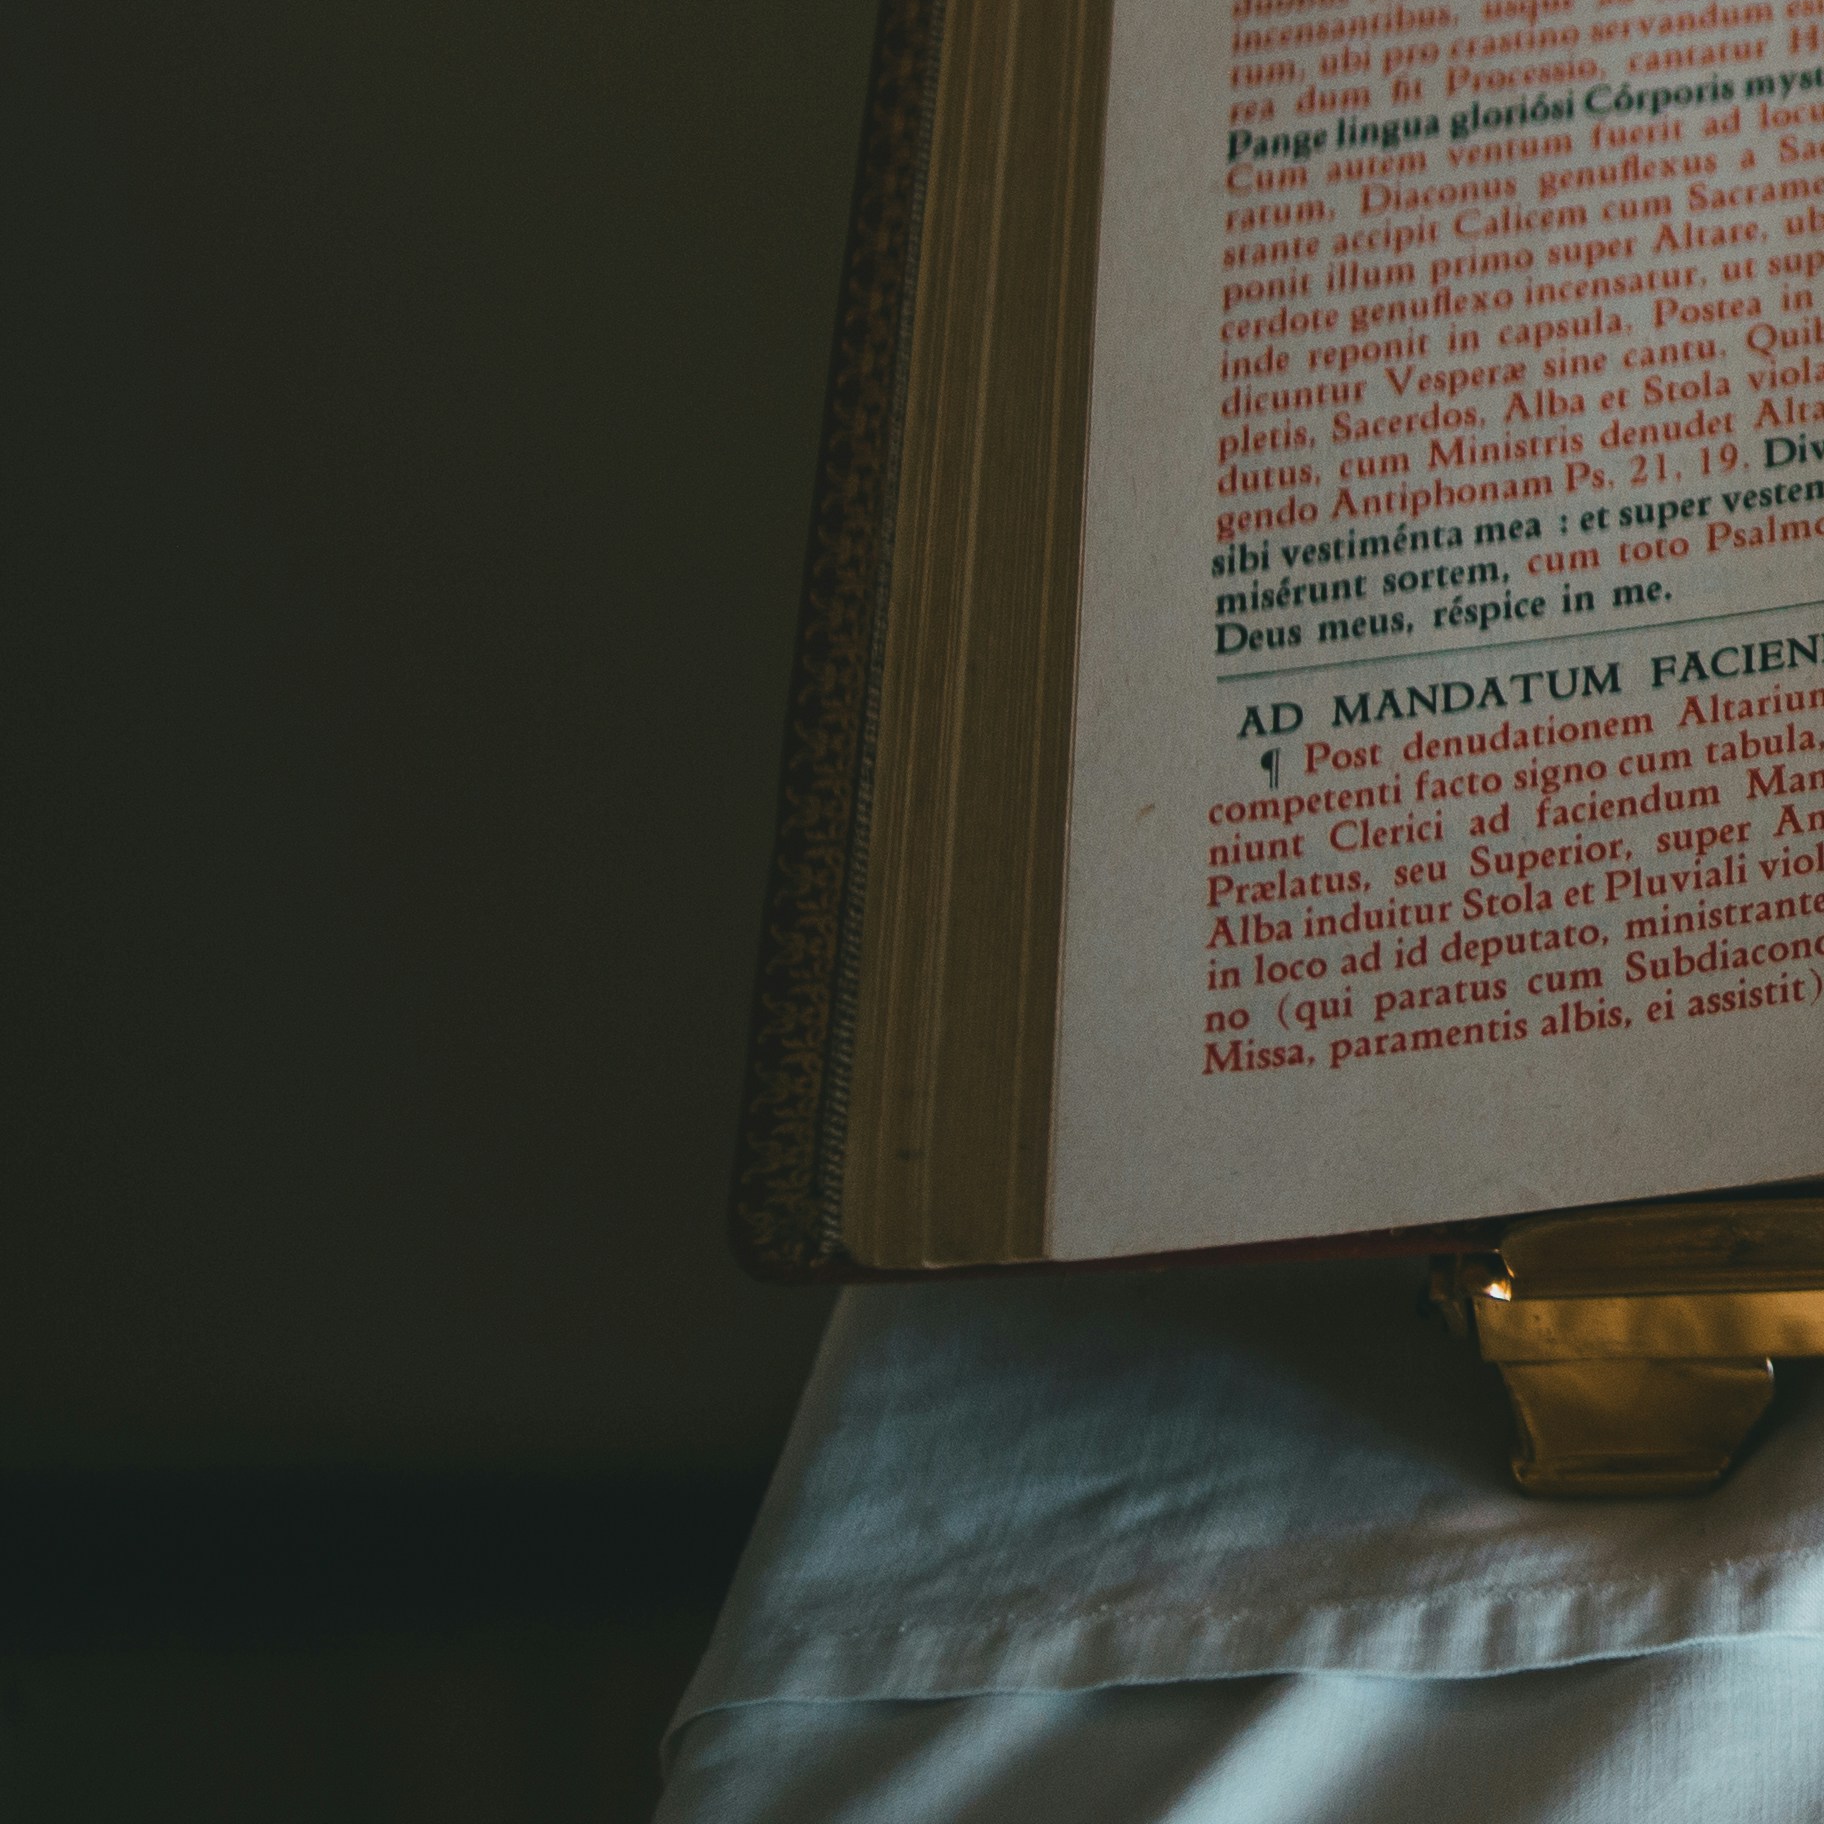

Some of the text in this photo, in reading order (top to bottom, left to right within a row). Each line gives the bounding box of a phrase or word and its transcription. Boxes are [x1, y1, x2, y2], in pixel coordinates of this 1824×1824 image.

[1226, 129, 1328, 164] Pange
[1336, 115, 1440, 150] lingua
[1449, 90, 1575, 141] gloriósi
[1583, 81, 1735, 117] Córporis
[1214, 581, 1672, 656] Deus meus, réspice in me.
[1237, 702, 1304, 740] AD
[1331, 662, 1622, 728] MANDATUM
[1207, 958, 1241, 991] in
[1254, 953, 1328, 986] loco
[1340, 940, 1382, 976] ad
[1394, 935, 1428, 970] id
[1440, 924, 1609, 968] deputato,
[1202, 1038, 1315, 1076] Missa,
[1329, 1009, 1528, 1070] paramentis
[1540, 997, 1633, 1037] albis,
[1646, 988, 1675, 1024] ei
